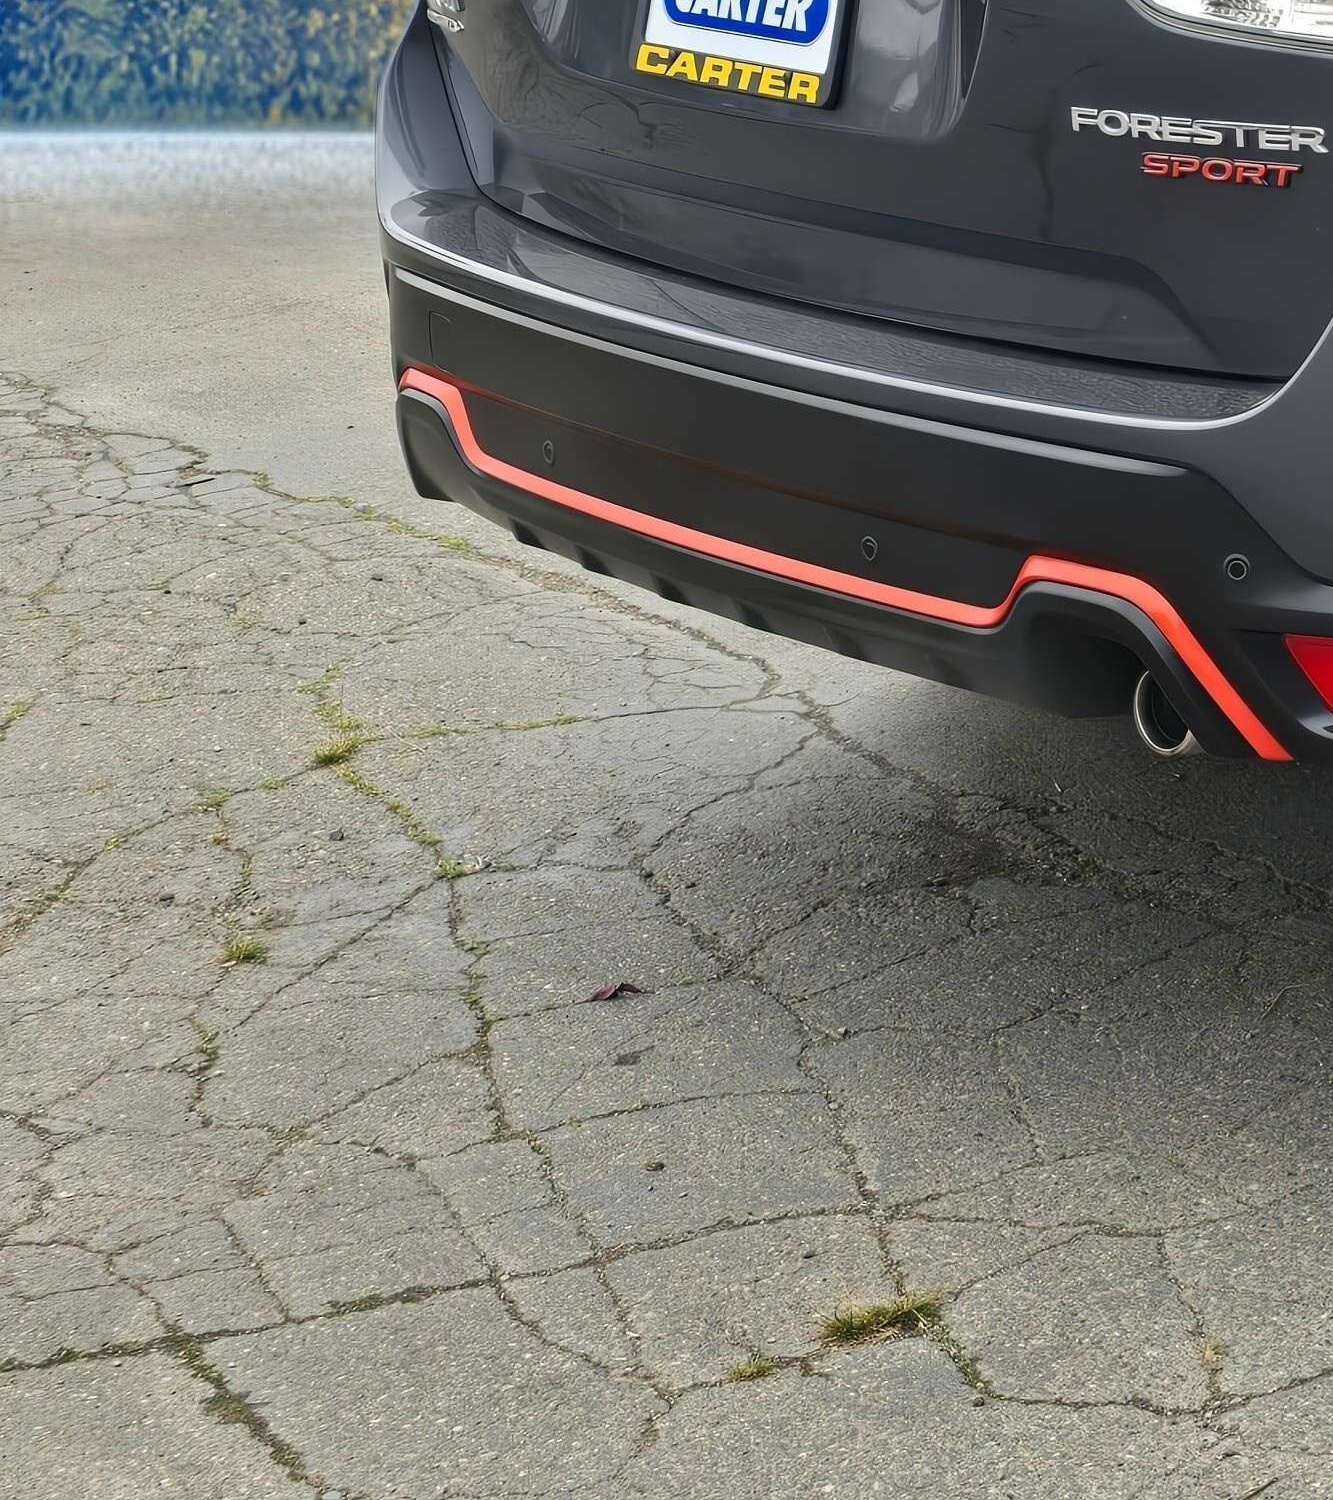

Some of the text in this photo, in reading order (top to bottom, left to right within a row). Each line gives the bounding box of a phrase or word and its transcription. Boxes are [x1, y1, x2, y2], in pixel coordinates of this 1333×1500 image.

[635, 43, 821, 105] CARTER
[1070, 106, 1330, 154] FORESTER
[1140, 151, 1303, 188] SPORT
